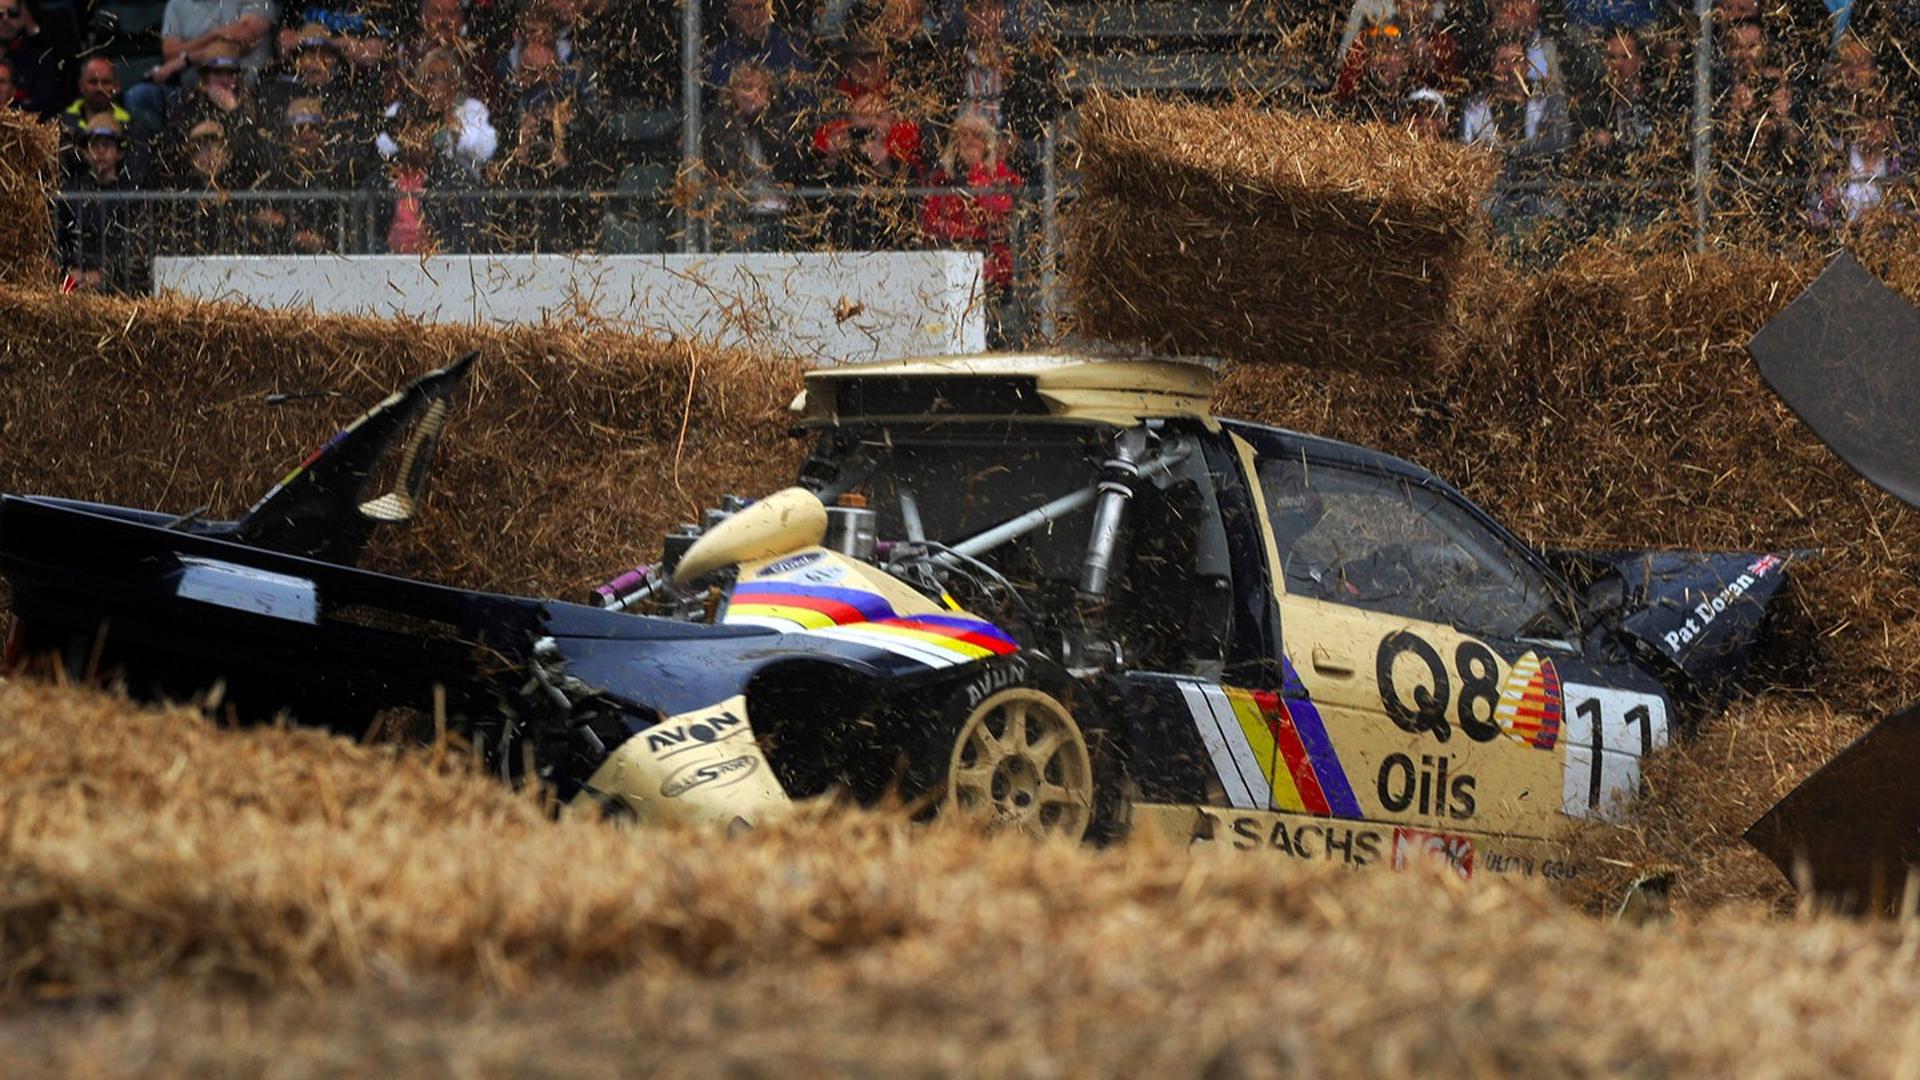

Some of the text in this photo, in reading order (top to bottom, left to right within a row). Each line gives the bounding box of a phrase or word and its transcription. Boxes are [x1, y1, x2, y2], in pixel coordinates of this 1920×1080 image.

[1664, 573, 1755, 652] Pat Doran
[1376, 630, 1502, 743] Q8
[647, 711, 741, 753] AVON
[1575, 697, 1652, 810] 11
[1377, 752, 1476, 821] Oils
[1232, 816, 1382, 866] SACHS
